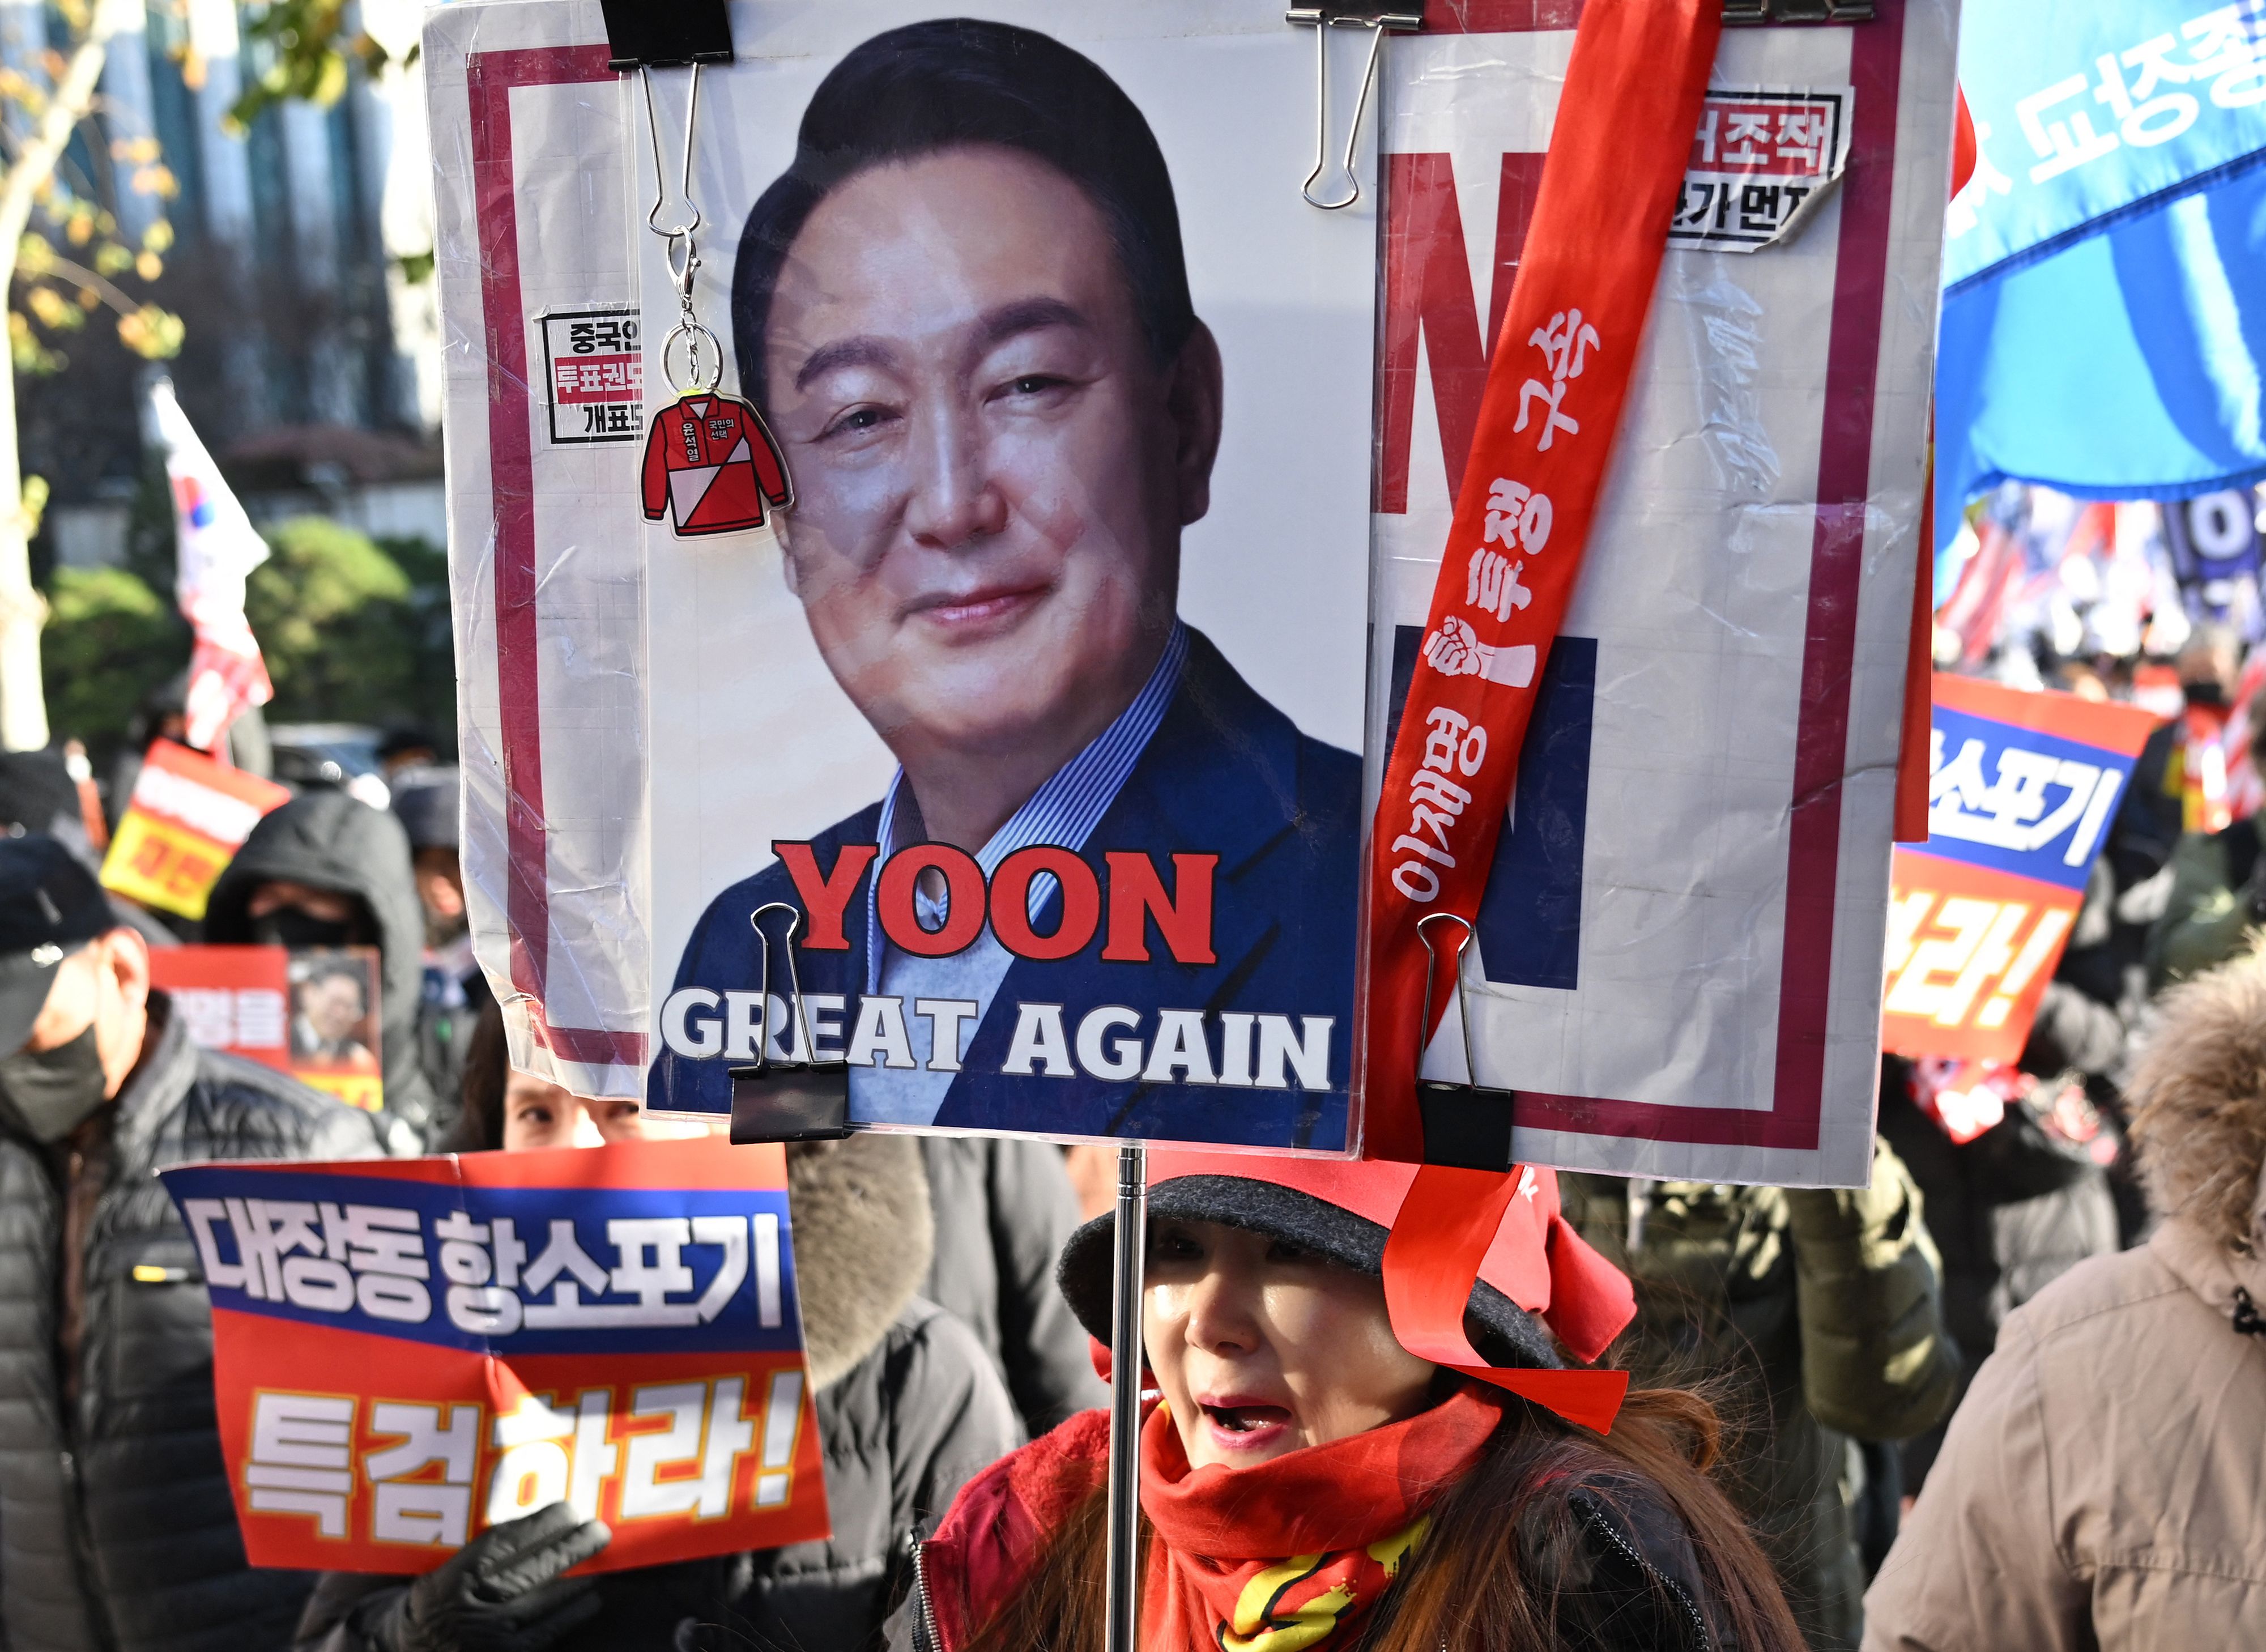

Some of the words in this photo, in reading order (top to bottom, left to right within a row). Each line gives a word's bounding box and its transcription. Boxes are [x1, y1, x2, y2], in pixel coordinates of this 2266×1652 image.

[683, 423, 700, 462] 윤석열
[709, 419, 735, 429] 국민의
[710, 429, 728, 440] 선택
[1391, 706, 1488, 903] 이재명
[1466, 477, 1553, 624] 투쟁
[1513, 308, 1601, 453] 구속
[1929, 729, 2124, 867] 소포기
[771, 839, 1221, 966] YOON
[659, 987, 979, 1073] GREAT
[1000, 1000, 1337, 1092] AGAIN
[182, 1197, 432, 1325] 대장동
[434, 1210, 783, 1336] 항소포기
[244, 1368, 804, 1549] 특검하라!
